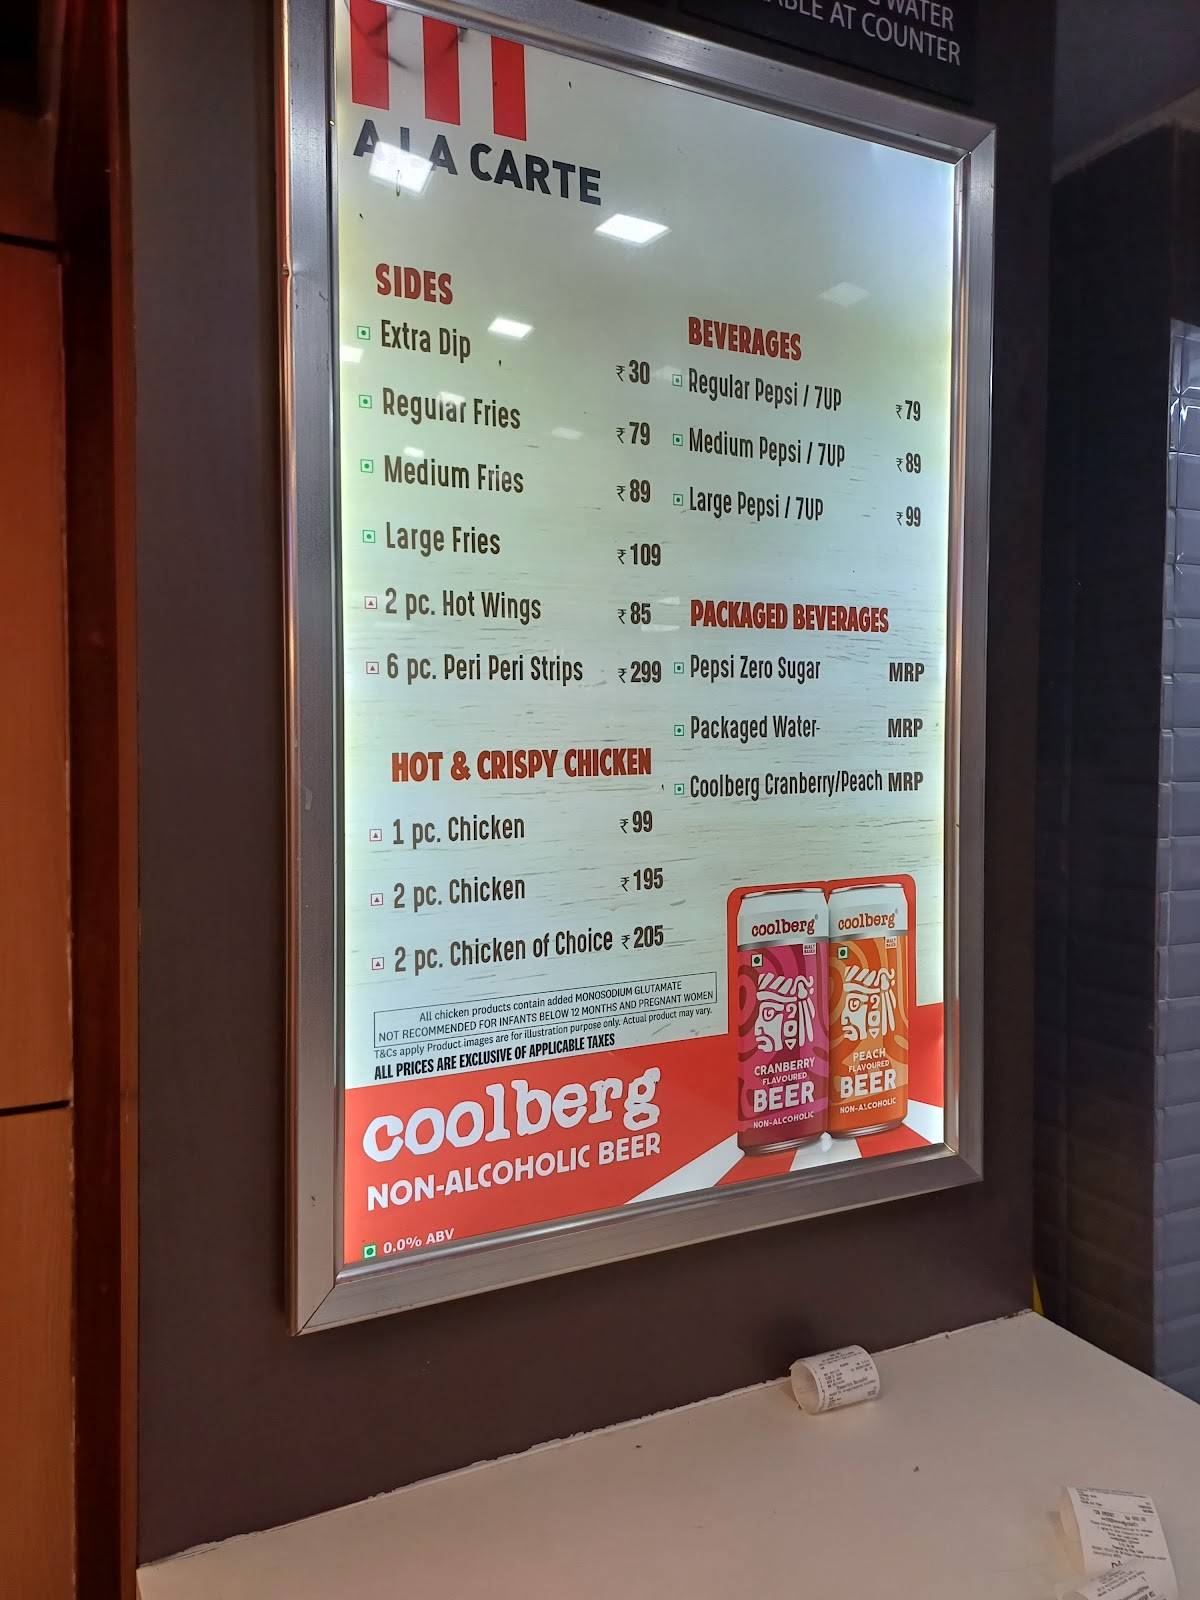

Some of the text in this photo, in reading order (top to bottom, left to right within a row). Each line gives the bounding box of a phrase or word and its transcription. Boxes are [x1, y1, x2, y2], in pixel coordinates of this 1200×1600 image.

[830, 1, 857, 30] AT
[862, 12, 960, 66] COUNTER
[353, 119, 380, 157] A
[470, 142, 601, 206] CARTE
[375, 263, 453, 305] SIDES
[381, 319, 471, 363] Extra Dip
[688, 316, 802, 361] BEVERAGES
[688, 368, 842, 411] Regular Pepsi / 7UP
[383, 387, 521, 430] Regular Fries
[689, 427, 845, 468] Medium Pepsi / 7UP
[384, 455, 524, 494] Medium Fries
[689, 486, 824, 522] Large Pepsi / 7UP
[386, 522, 501, 557] Large Fries
[385, 587, 541, 625] 2 pc. Hot Wings
[690, 599, 889, 633] PACKAGED BEVERAGES
[386, 653, 584, 686] 6 pc. Peri Peri Strips
[690, 654, 821, 685] Pepsi Zero Sugar
[889, 662, 925, 682] MRP
[691, 715, 768, 744] Packaged
[888, 718, 923, 738] MRP
[391, 748, 652, 783] HOT & CRISPY CHICKEN
[888, 772, 923, 792] MRP
[690, 770, 883, 802] Coolberg Cranberry/Peach
[392, 814, 525, 849] 1 pc. Chicken
[393, 877, 525, 913] 2 pc. Chicken
[751, 918, 815, 937] coolberg
[838, 912, 895, 931] coolberg
[394, 928, 613, 976] 2 pc. Chicken of Choice
[378, 991, 714, 1042] NOT RECOMMENDED FOR INFANTS BELOW 12 MONTHS AND PREGNANT WOMEN
[419, 980, 682, 1022] All chicken products contain added MONOSODIUM GLUTAMATE
[375, 1006, 713, 1059] T&Cs apply Product images are for illustration purpose only. Actual product may vary.
[375, 1033, 615, 1080] ALL PRICES ARE EXCLUSIVE OF APPLICABLE TAXES
[754, 1056, 816, 1077] CRANBERRY
[848, 1059, 890, 1073] FLAVOURED
[852, 1047, 886, 1063] PEACH
[762, 1072, 808, 1086] FLAVOURED
[840, 1068, 897, 1099] BEER
[753, 1080, 815, 1114] BEER
[840, 1097, 897, 1114] NON-ALCOHOLIC
[362, 1067, 661, 1163] coolberg
[753, 1111, 814, 1129] NON-ALCOHOLIC
[367, 1132, 661, 1212] NON-ALCOHOLIC BEER
[383, 1228, 455, 1255] 0.0% ABV
